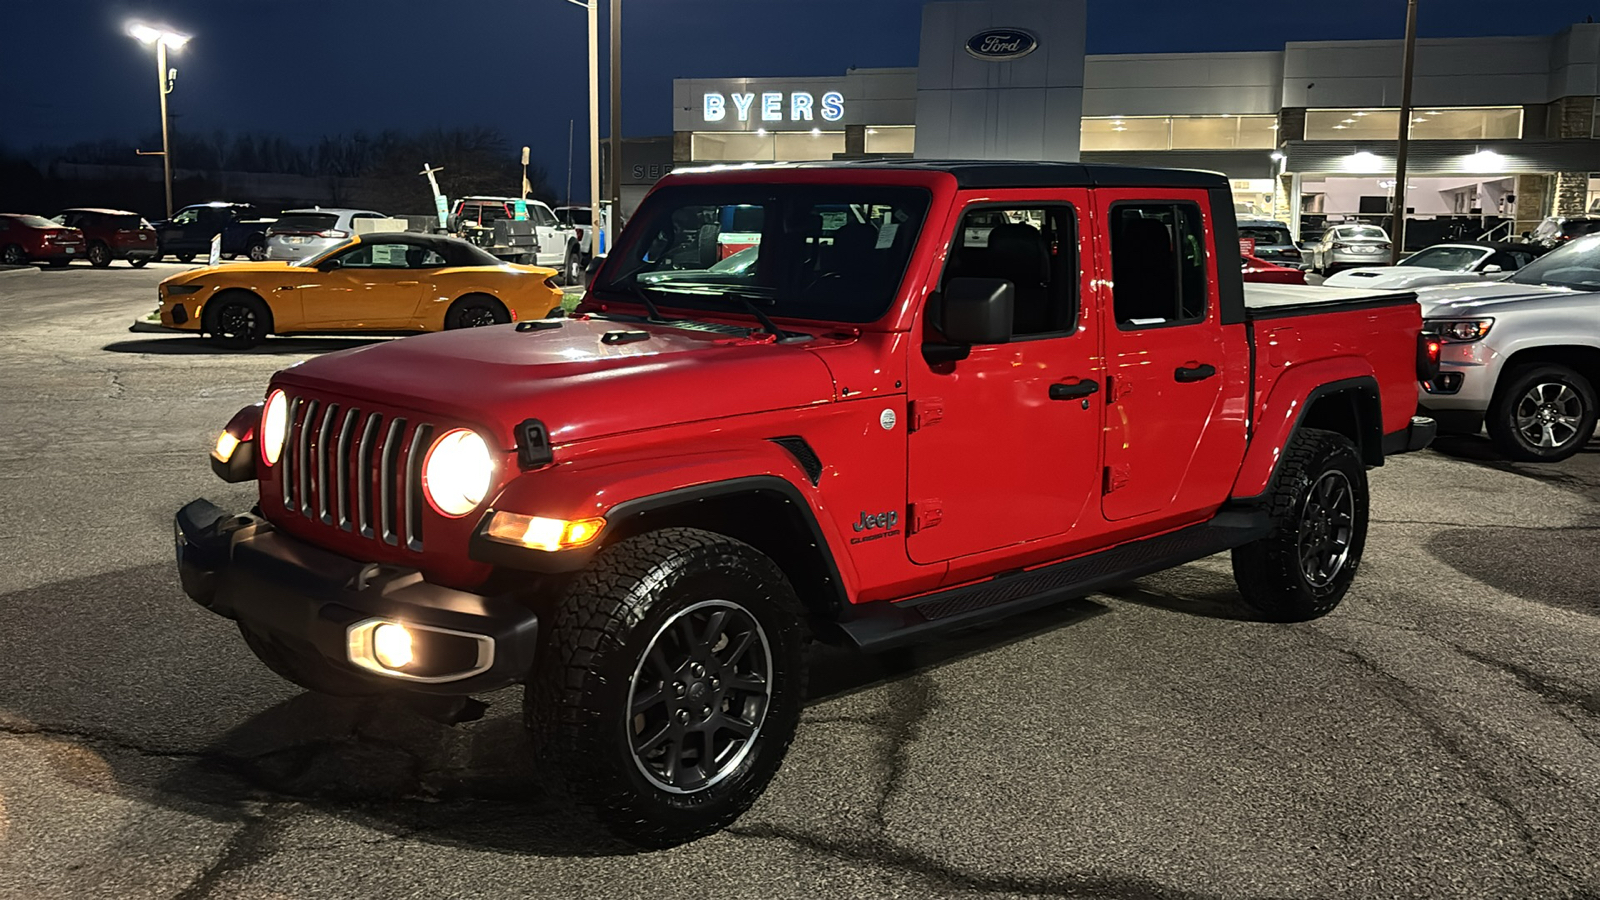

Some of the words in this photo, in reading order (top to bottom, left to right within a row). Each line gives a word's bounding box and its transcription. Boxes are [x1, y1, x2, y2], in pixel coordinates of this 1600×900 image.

[980, 35, 1021, 52] Ford
[703, 91, 845, 122] BYERS
[853, 510, 899, 532] Jeep
